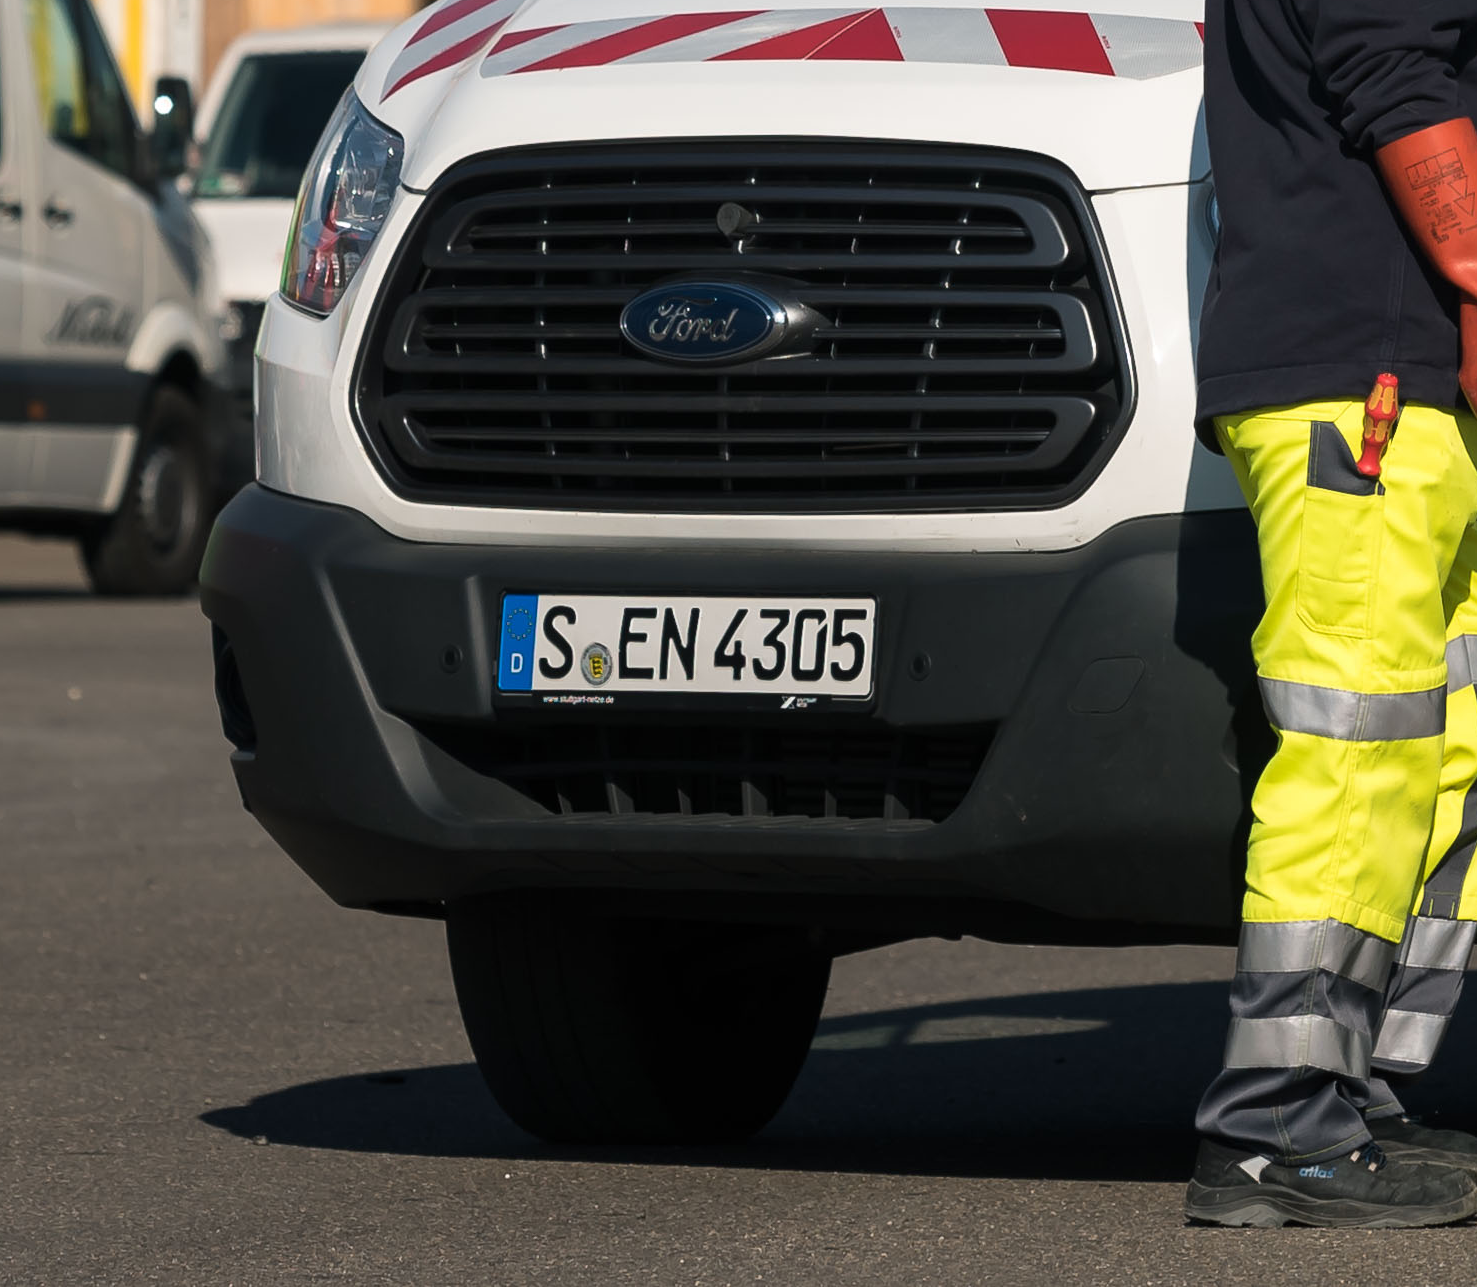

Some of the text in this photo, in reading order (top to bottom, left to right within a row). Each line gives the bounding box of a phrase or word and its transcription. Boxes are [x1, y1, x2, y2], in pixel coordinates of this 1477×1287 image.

[648, 296, 739, 342] Ford
[537, 604, 868, 682] S EN 4305
[509, 652, 523, 673] D
[1298, 1165, 1335, 1179] atlas
